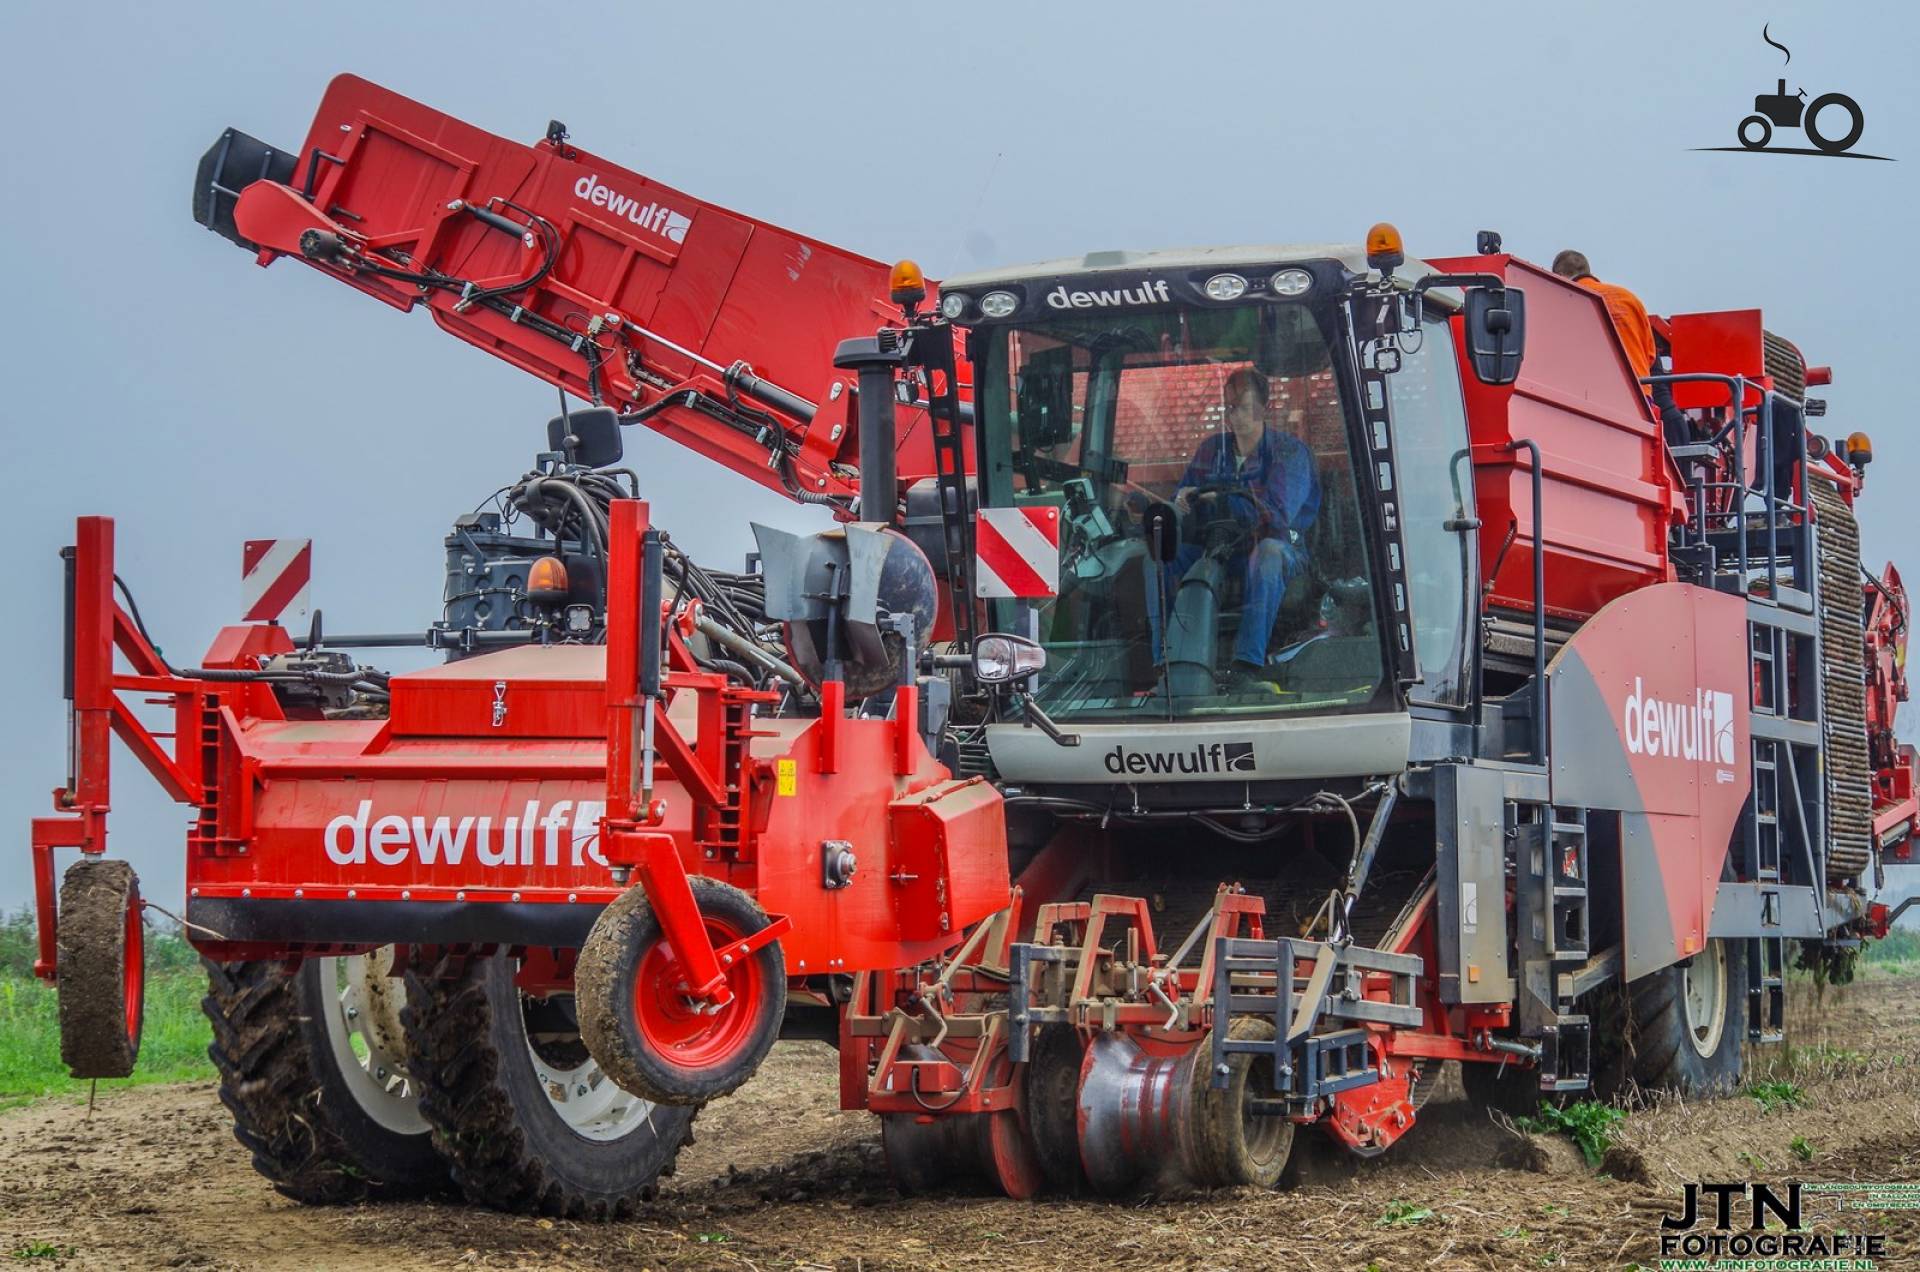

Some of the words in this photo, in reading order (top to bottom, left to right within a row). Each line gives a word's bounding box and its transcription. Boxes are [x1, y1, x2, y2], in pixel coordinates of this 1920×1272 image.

[574, 174, 670, 233] dewulf
[1047, 280, 1170, 309] dewulf
[1625, 676, 1712, 762] dewulf
[1104, 743, 1221, 774] dewulf
[324, 799, 573, 867] dewulf
